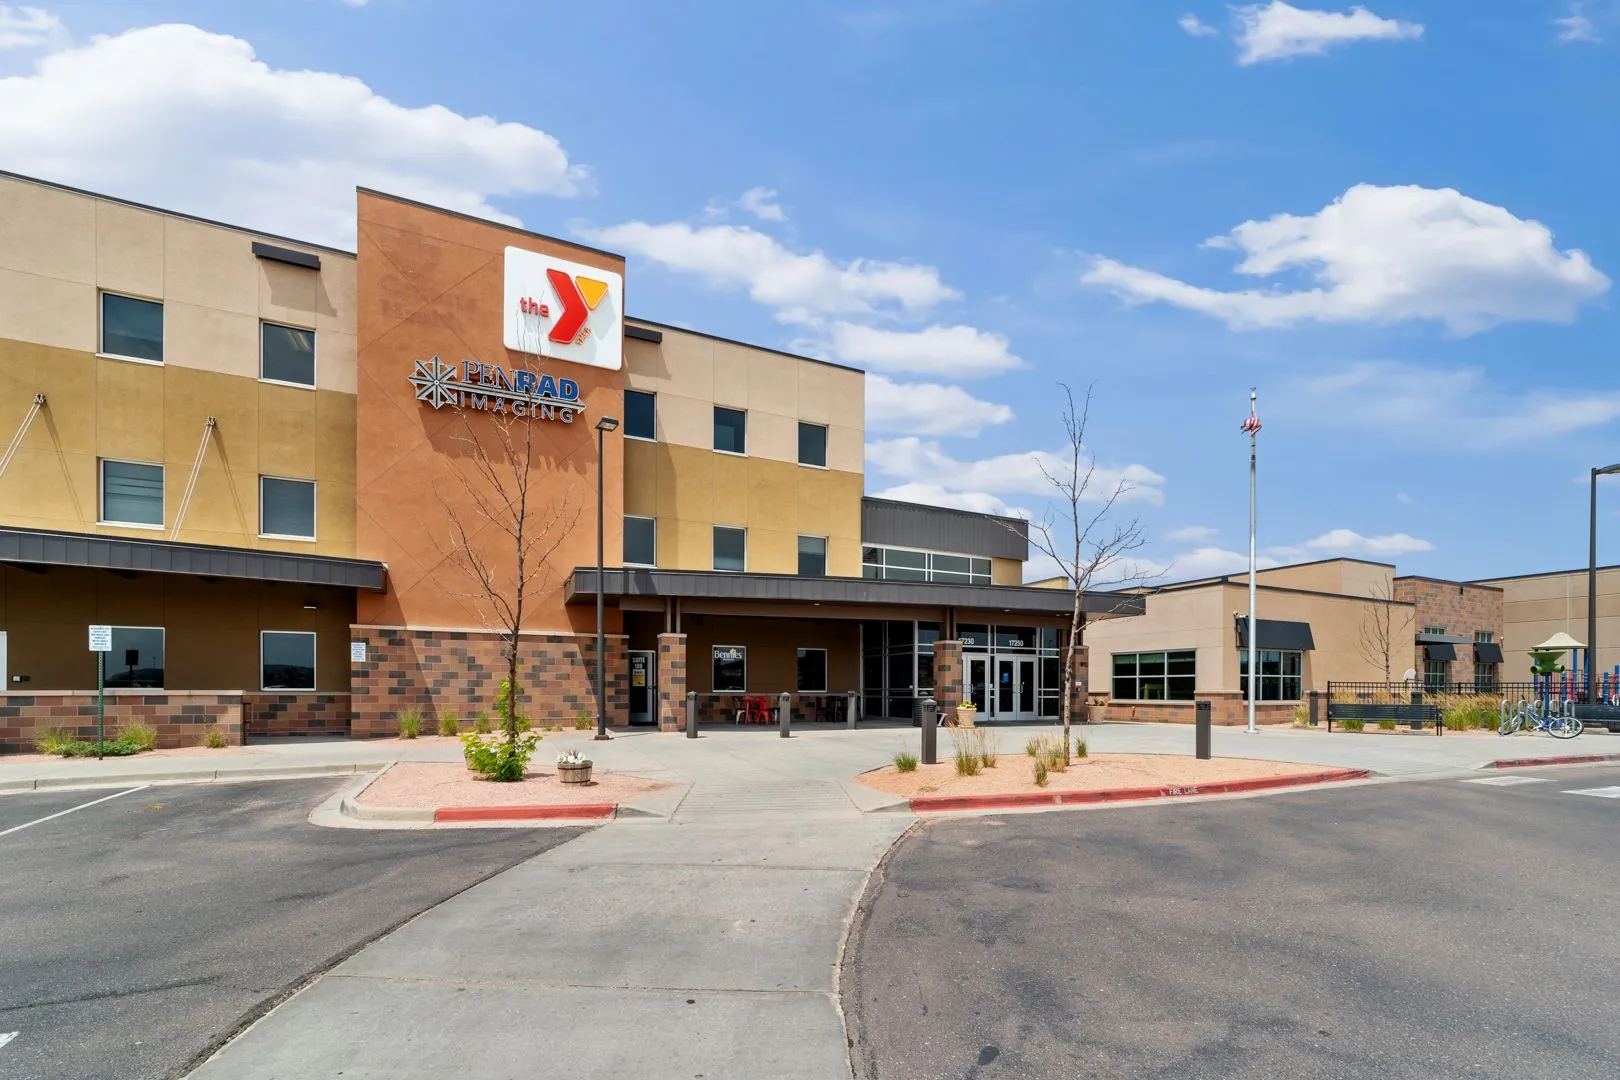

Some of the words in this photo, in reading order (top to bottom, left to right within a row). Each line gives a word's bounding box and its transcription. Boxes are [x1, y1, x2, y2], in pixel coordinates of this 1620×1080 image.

[520, 297, 549, 317] the
[462, 360, 580, 401] PENRAD
[460, 391, 573, 423] IMAGING
